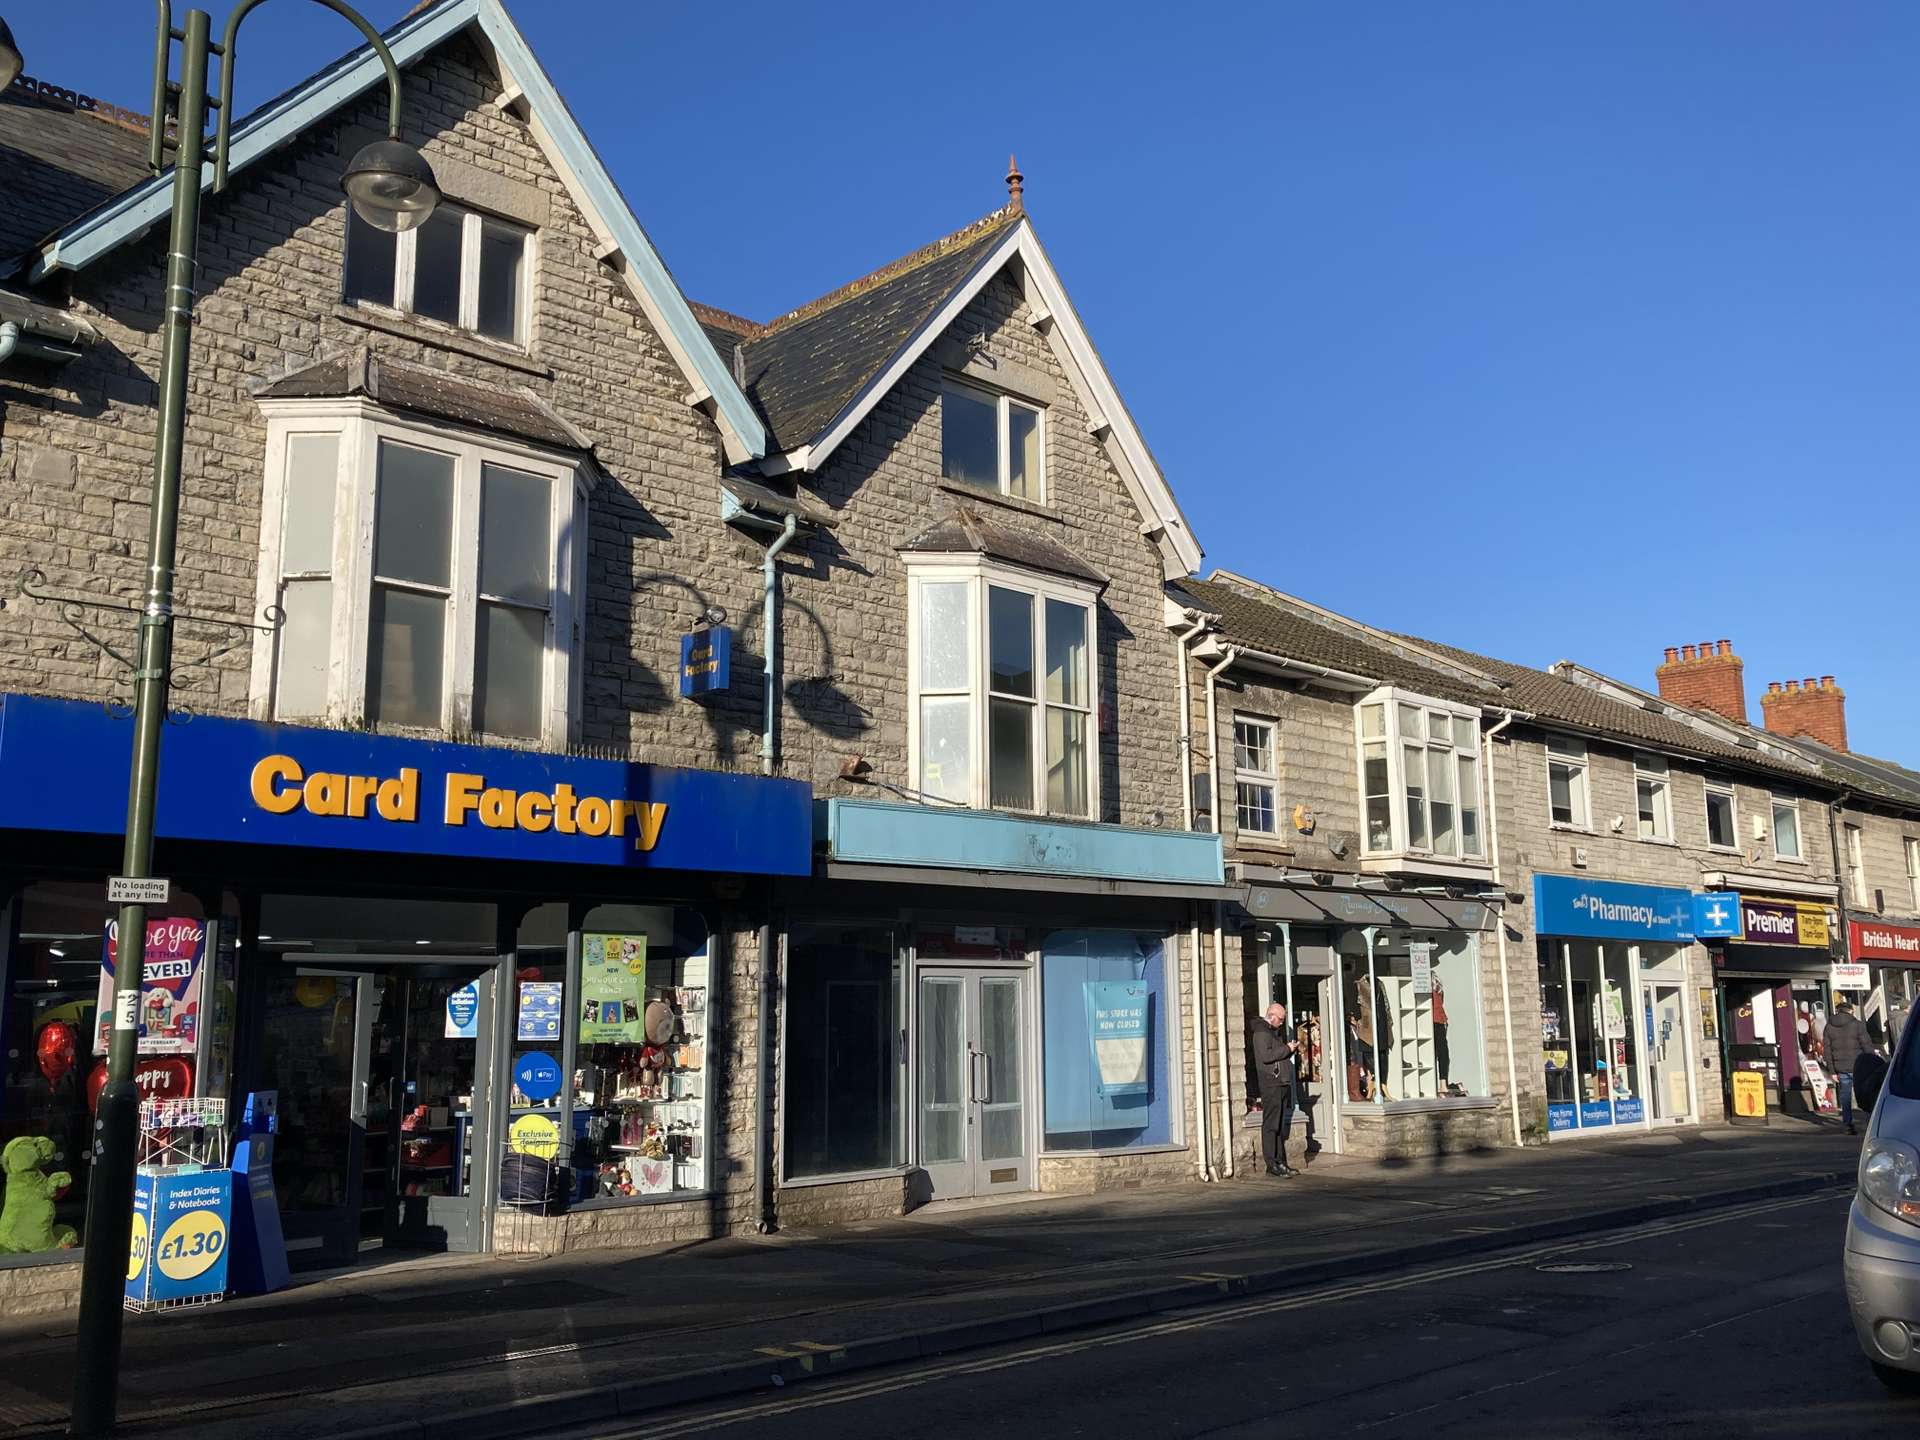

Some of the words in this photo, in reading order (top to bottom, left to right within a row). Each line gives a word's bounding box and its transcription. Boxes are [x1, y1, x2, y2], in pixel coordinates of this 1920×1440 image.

[250, 754, 420, 823] Card
[444, 771, 668, 852] Factory
[114, 881, 128, 889] No
[130, 881, 165, 892] loading
[125, 892, 142, 900] any
[144, 890, 165, 900] time
[1589, 897, 1654, 928] Pharmacy
[1747, 909, 1795, 934] Premier
[168, 924, 204, 953] you
[1862, 930, 1893, 949] British
[1894, 934, 1919, 951] Heart
[126, 1011, 135, 1023] 5
[135, 1070, 171, 1090] appy
[517, 1129, 553, 1138] Exclusive
[170, 1188, 192, 1199] Index
[193, 1186, 221, 1196] Diaries
[168, 1202, 177, 1210] &
[177, 1197, 221, 1209] Notebooks
[159, 1230, 222, 1260] £1.30
